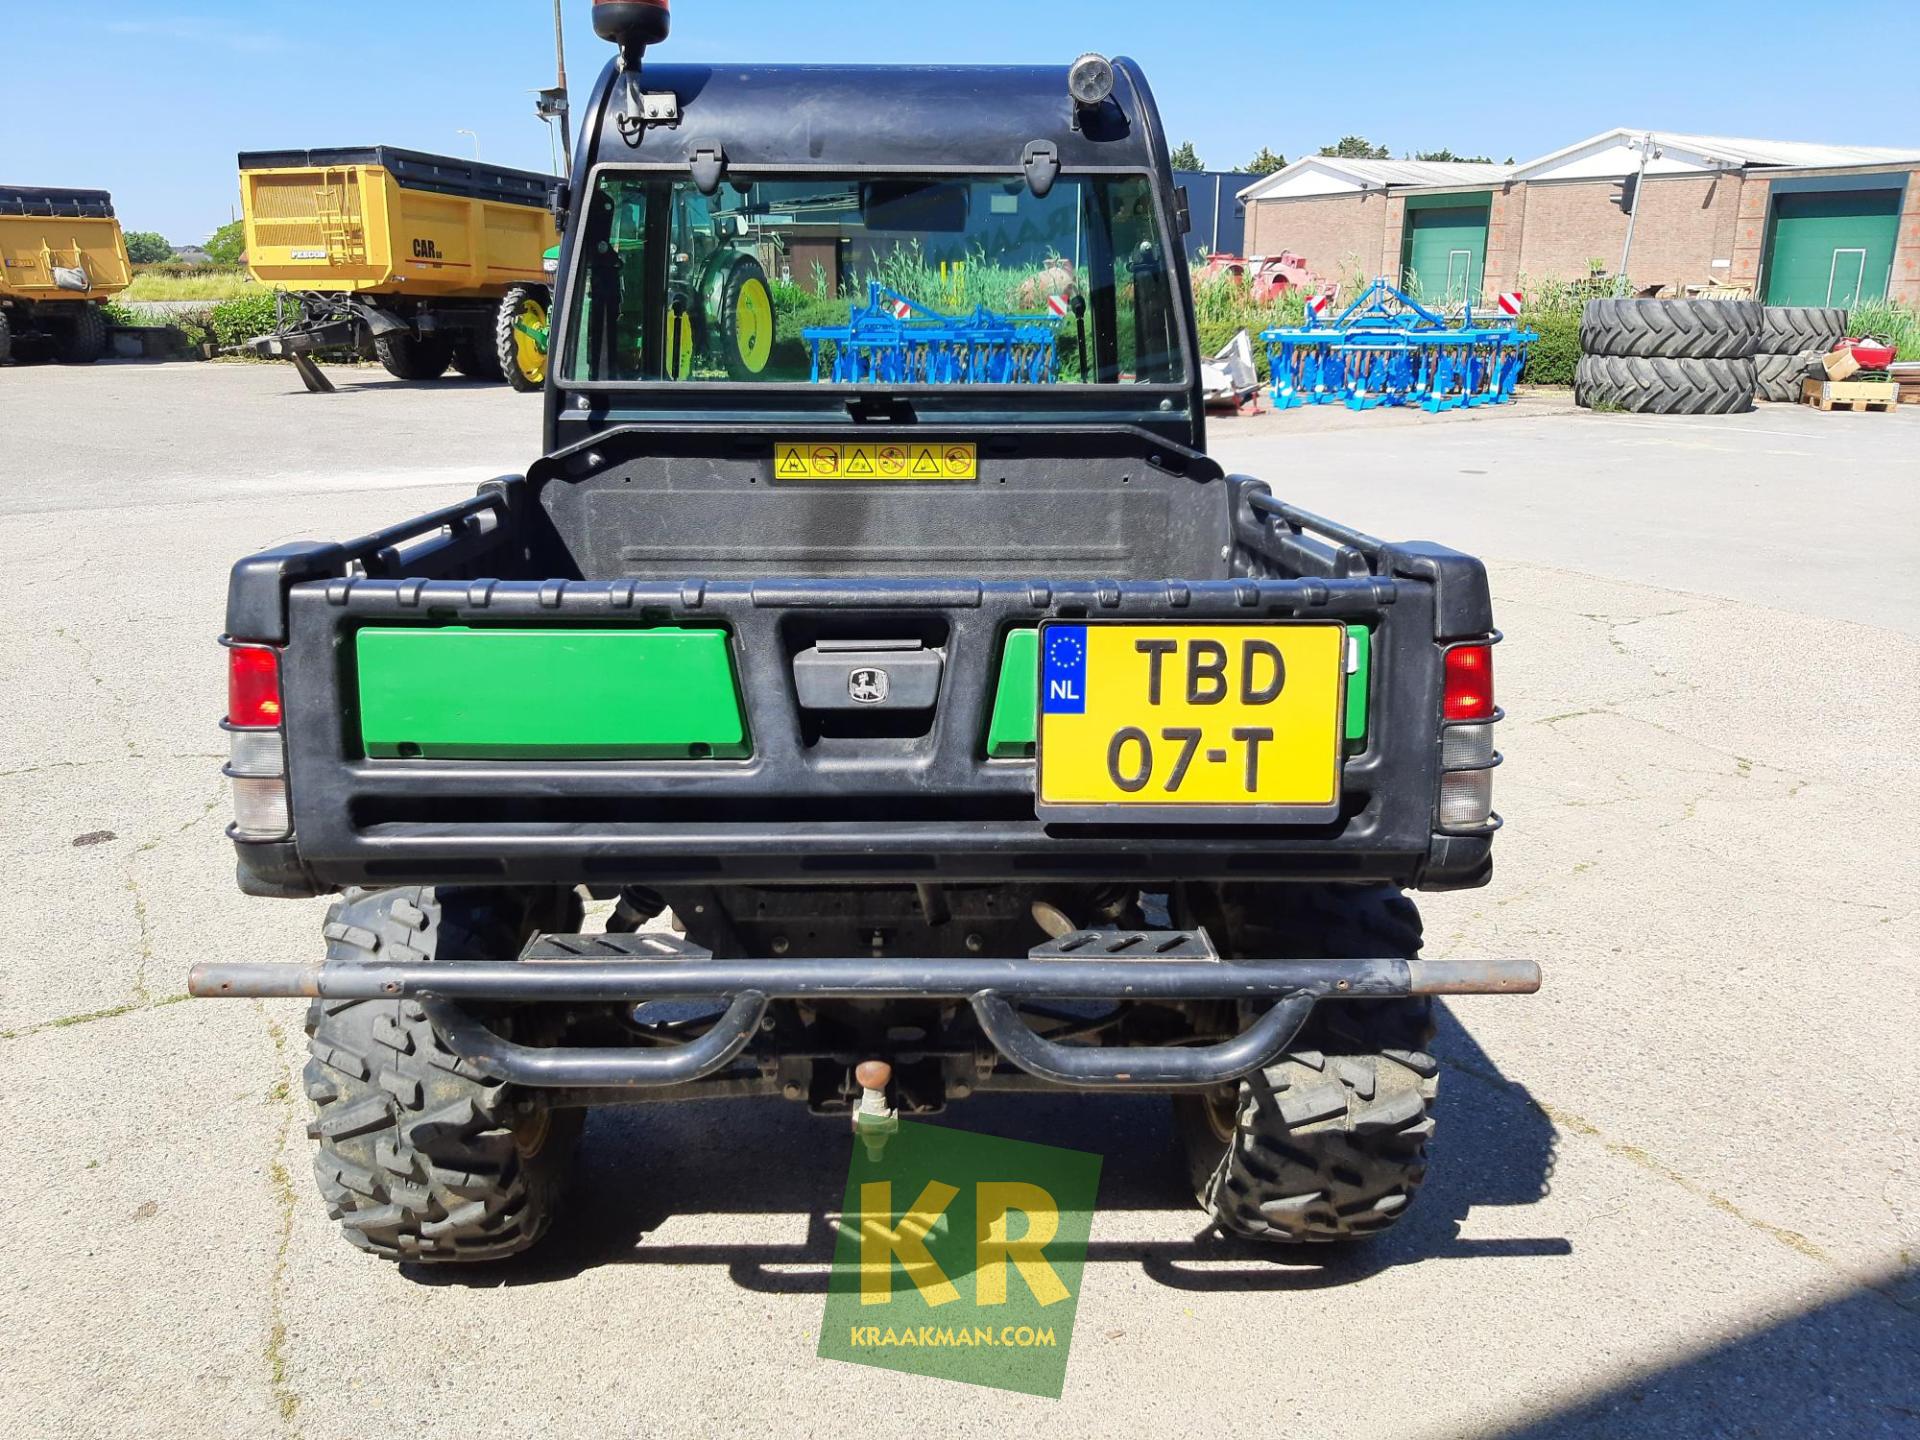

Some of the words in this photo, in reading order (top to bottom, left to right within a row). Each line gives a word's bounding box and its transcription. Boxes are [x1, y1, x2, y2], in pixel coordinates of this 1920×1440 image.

[1050, 680, 1080, 700] NL
[1134, 639, 1286, 706] TBD
[1106, 726, 1274, 793] 07-T
